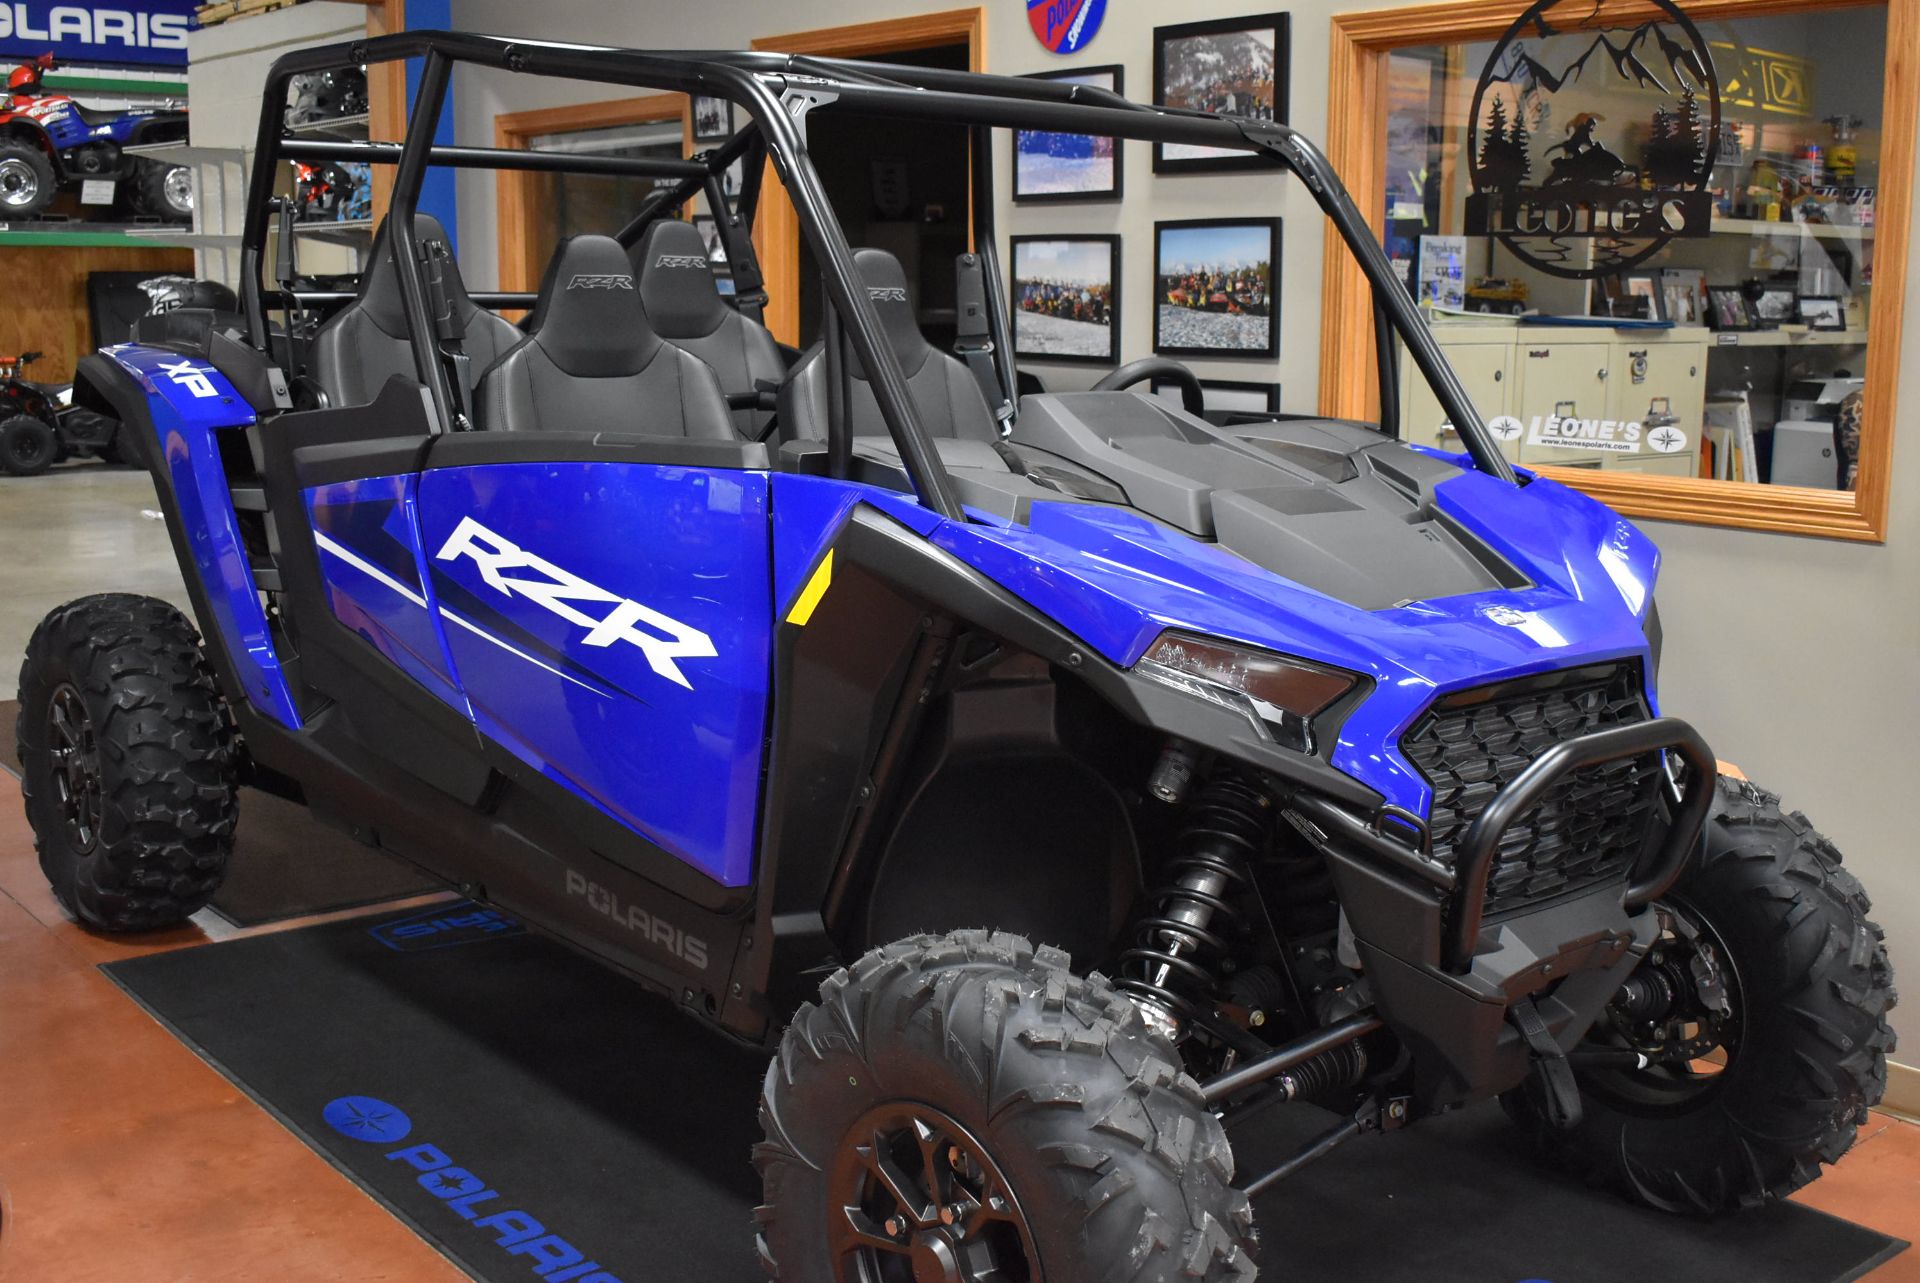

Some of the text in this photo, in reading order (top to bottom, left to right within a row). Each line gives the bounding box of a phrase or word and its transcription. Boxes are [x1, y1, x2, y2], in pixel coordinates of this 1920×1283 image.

[655, 254, 706, 269] RZR
[567, 274, 633, 290] RZR
[867, 287, 906, 301] ZR
[158, 360, 219, 398] XP
[1541, 438, 1630, 451] www.leonespolaris.com
[436, 515, 719, 691] RZR
[566, 869, 708, 969] POLARIS
